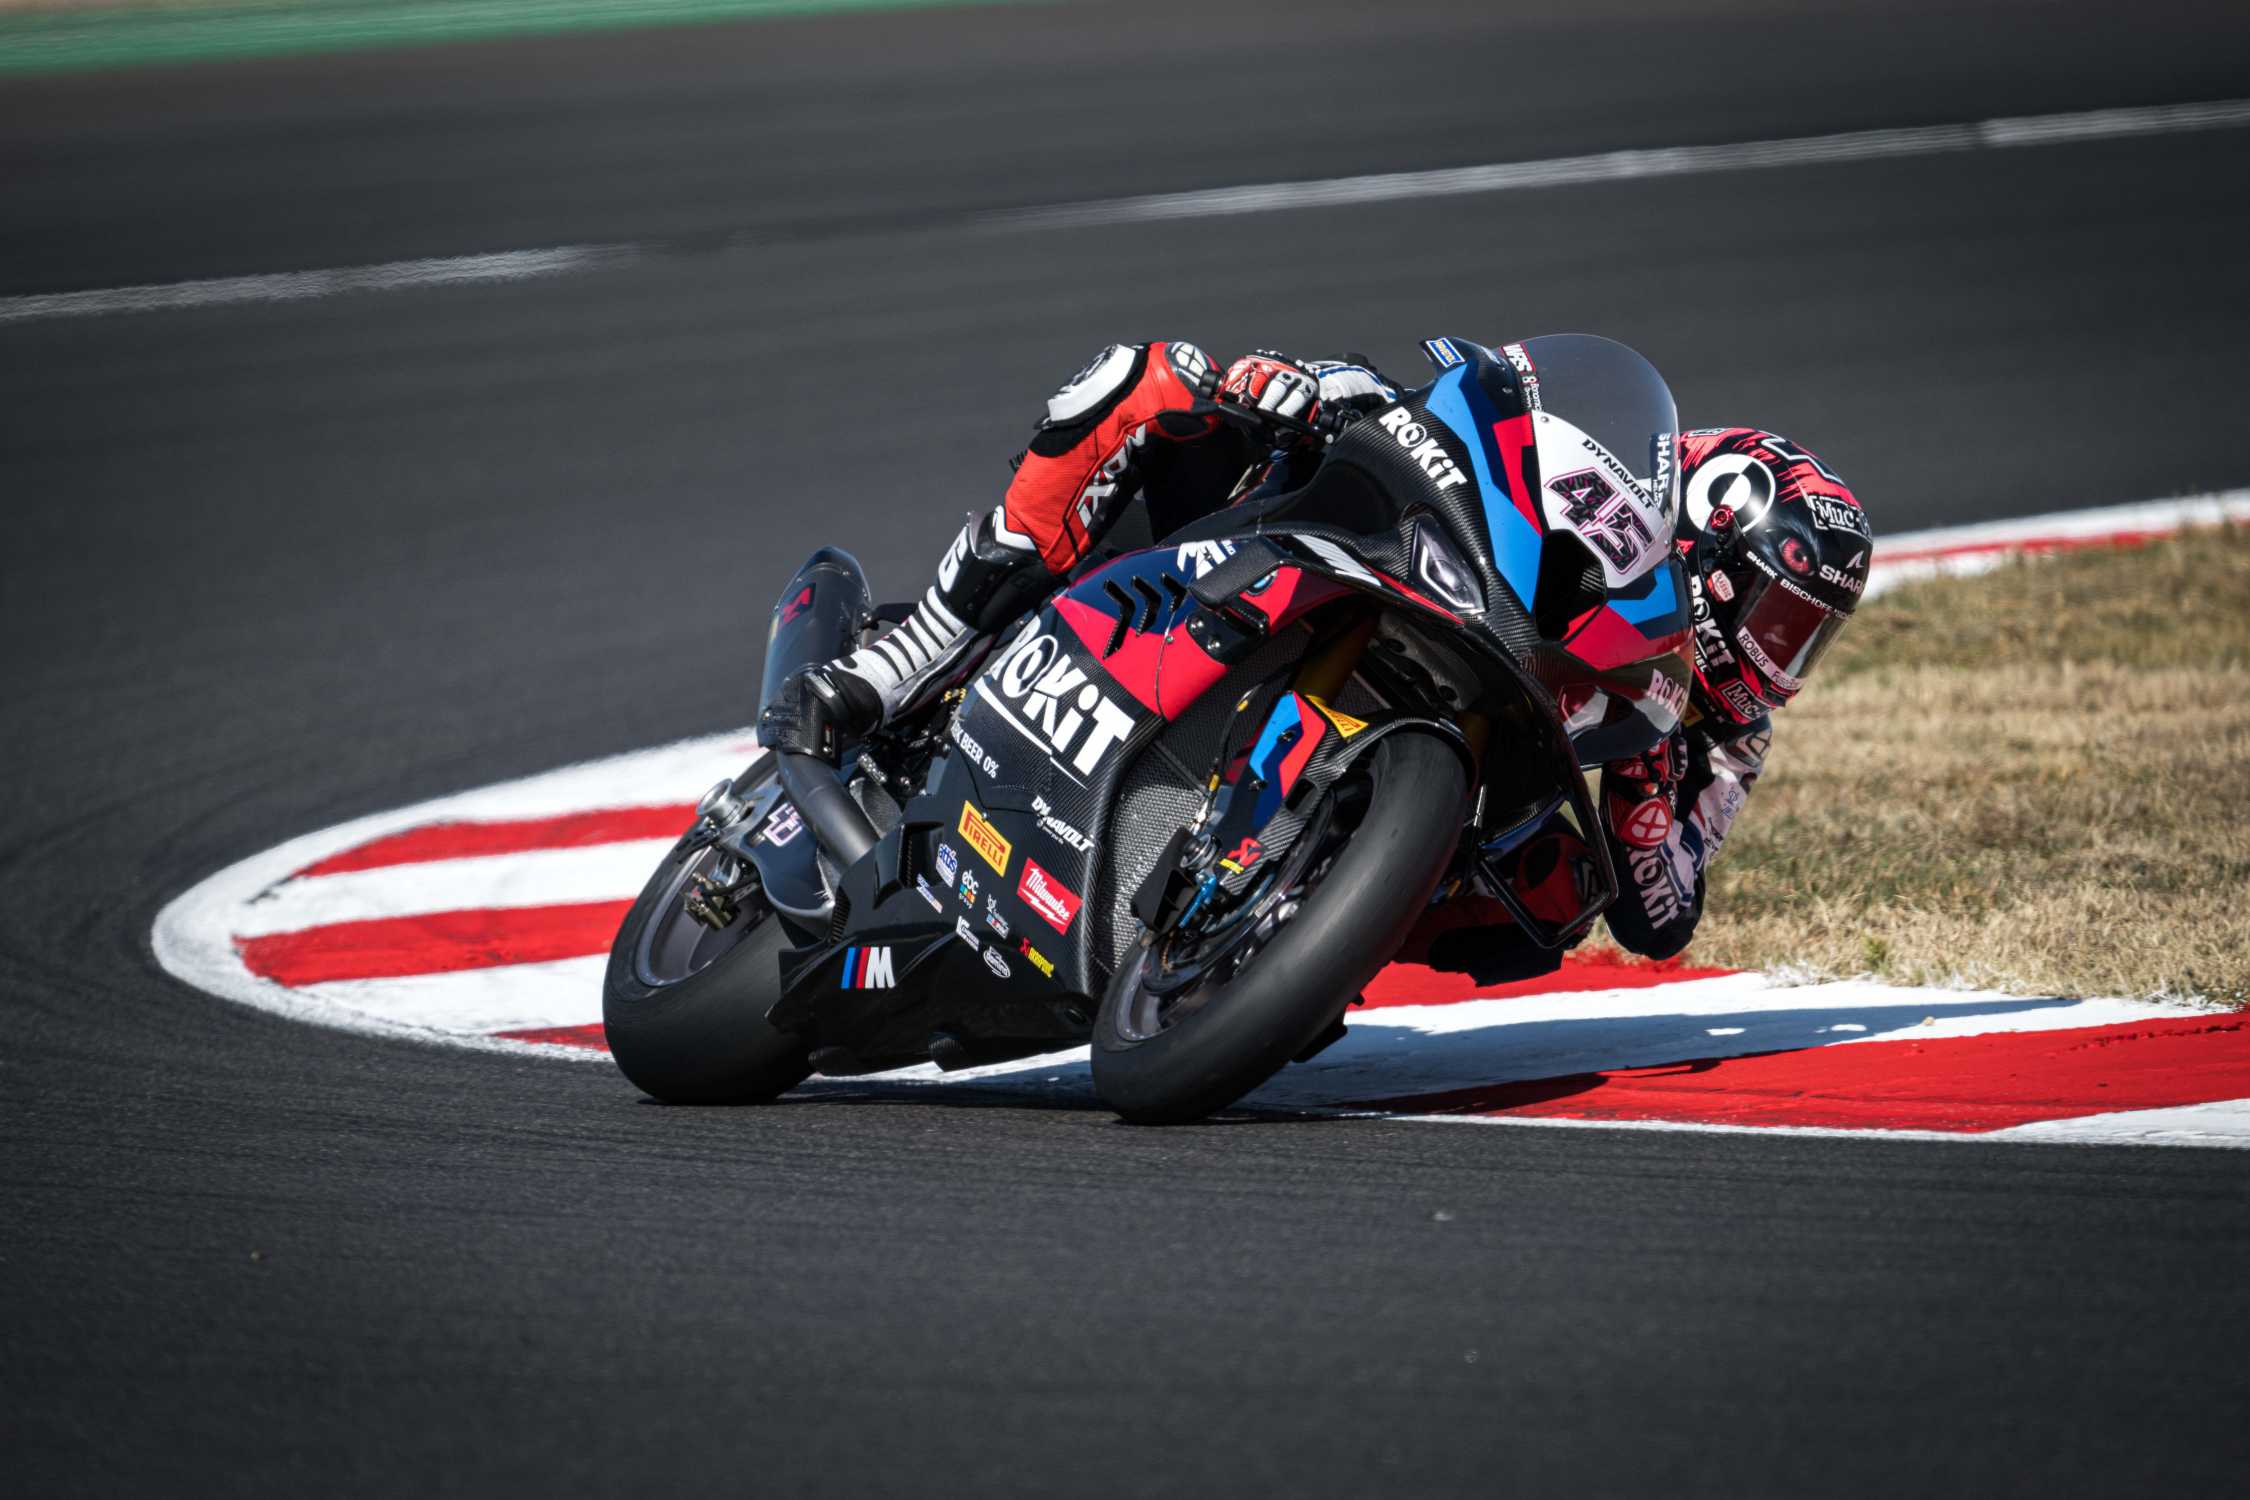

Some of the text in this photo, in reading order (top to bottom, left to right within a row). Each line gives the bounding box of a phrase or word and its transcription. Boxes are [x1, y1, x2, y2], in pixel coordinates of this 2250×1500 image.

[1379, 406, 1468, 491] ROKiT
[1582, 438, 1655, 509] DYNAVOLT
[1544, 466, 1655, 575] 45
[1746, 550, 1778, 580] SHARK
[1819, 564, 1866, 594] SHAR
[1780, 578, 1833, 611] BISCHOFF
[1739, 633, 1770, 668] ROBUS
[960, 732, 983, 764] BEER
[983, 756, 999, 778] 0%
[963, 810, 1006, 868] PIRELLI
[1032, 795, 1095, 851] DYNAVOLT
[1025, 868, 1070, 921] Milwaukee
[865, 947, 896, 988] M
